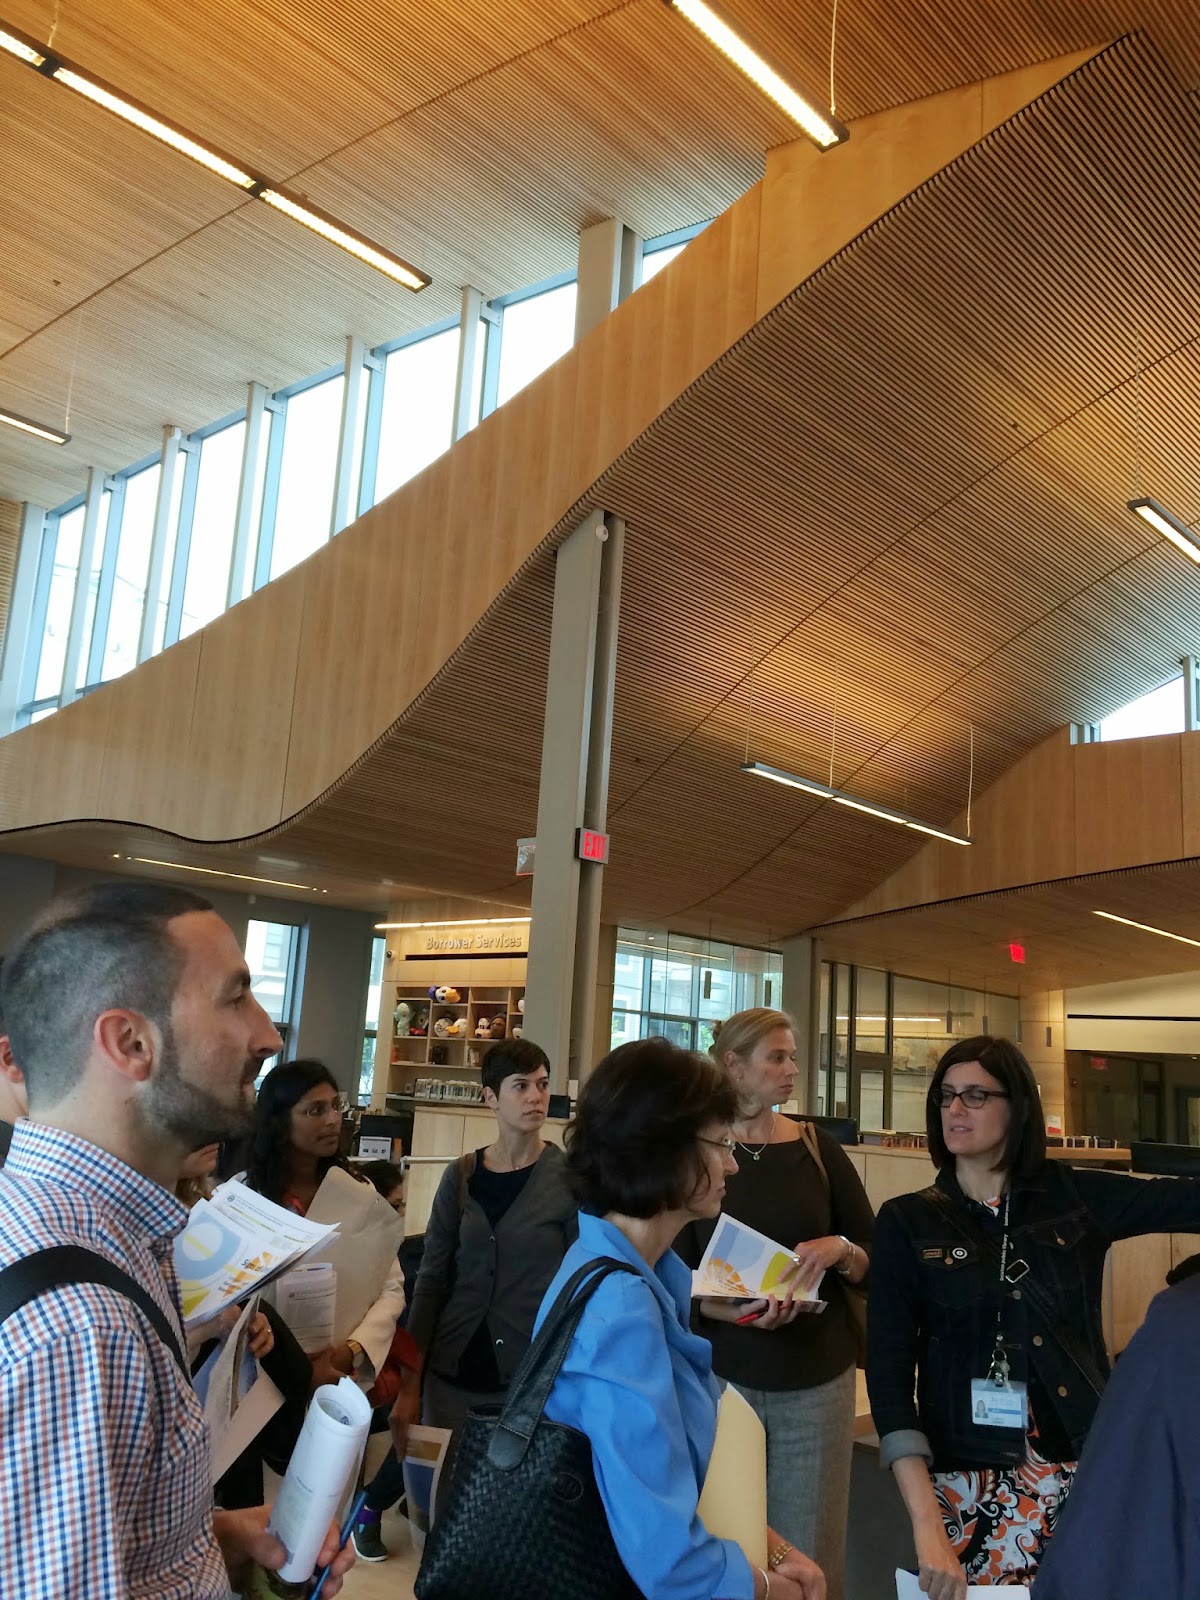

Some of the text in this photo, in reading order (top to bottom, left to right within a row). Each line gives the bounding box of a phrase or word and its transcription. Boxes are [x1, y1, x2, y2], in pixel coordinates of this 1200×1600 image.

[584, 831, 607, 860] EXIT
[426, 933, 522, 950] Borrower Services
